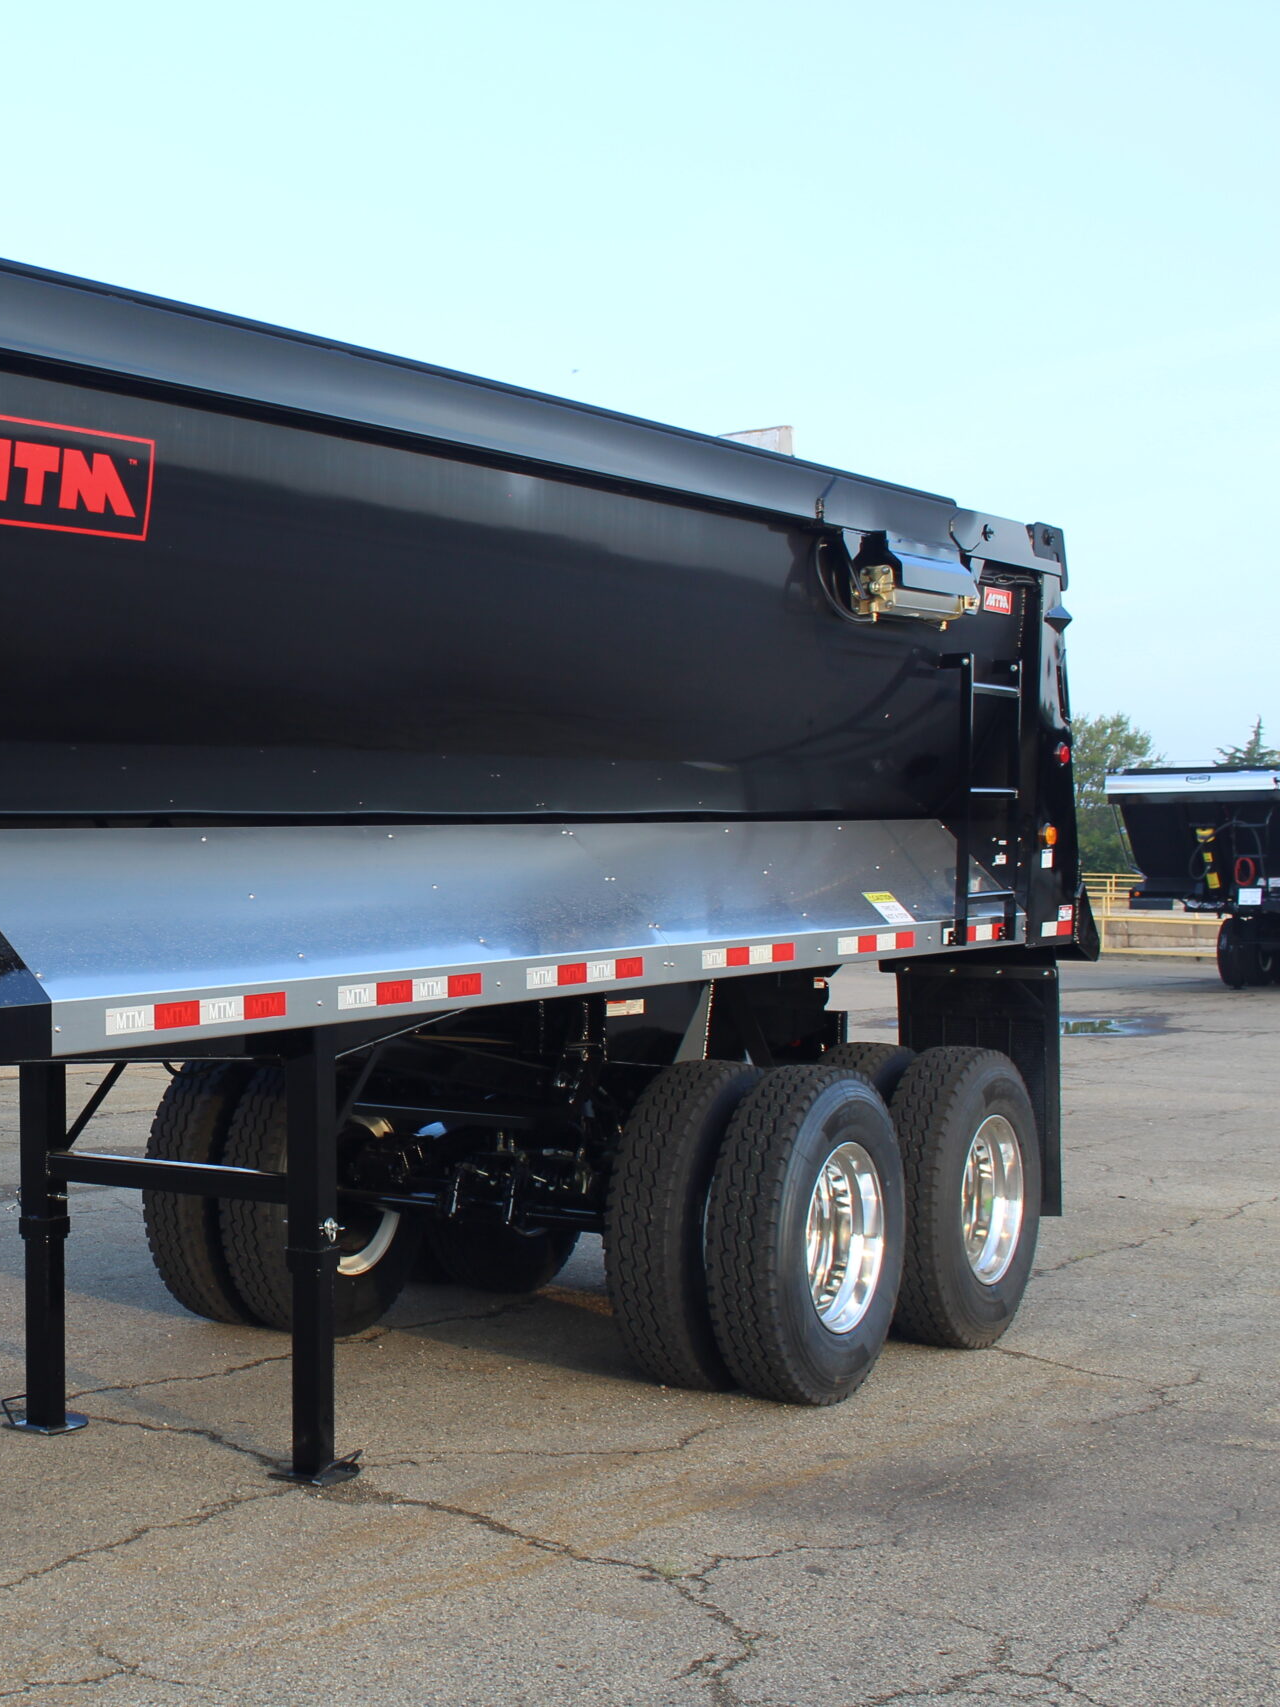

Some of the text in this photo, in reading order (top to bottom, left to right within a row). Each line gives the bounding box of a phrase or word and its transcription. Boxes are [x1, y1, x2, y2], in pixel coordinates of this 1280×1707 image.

[986, 593, 1009, 609] MTM
[532, 970, 552, 985] MTM
[592, 964, 610, 978] MTM
[346, 988, 368, 1005] MTM
[419, 981, 441, 997] MTM
[116, 1011, 145, 1029] MTM
[208, 1002, 235, 1020] MTM
